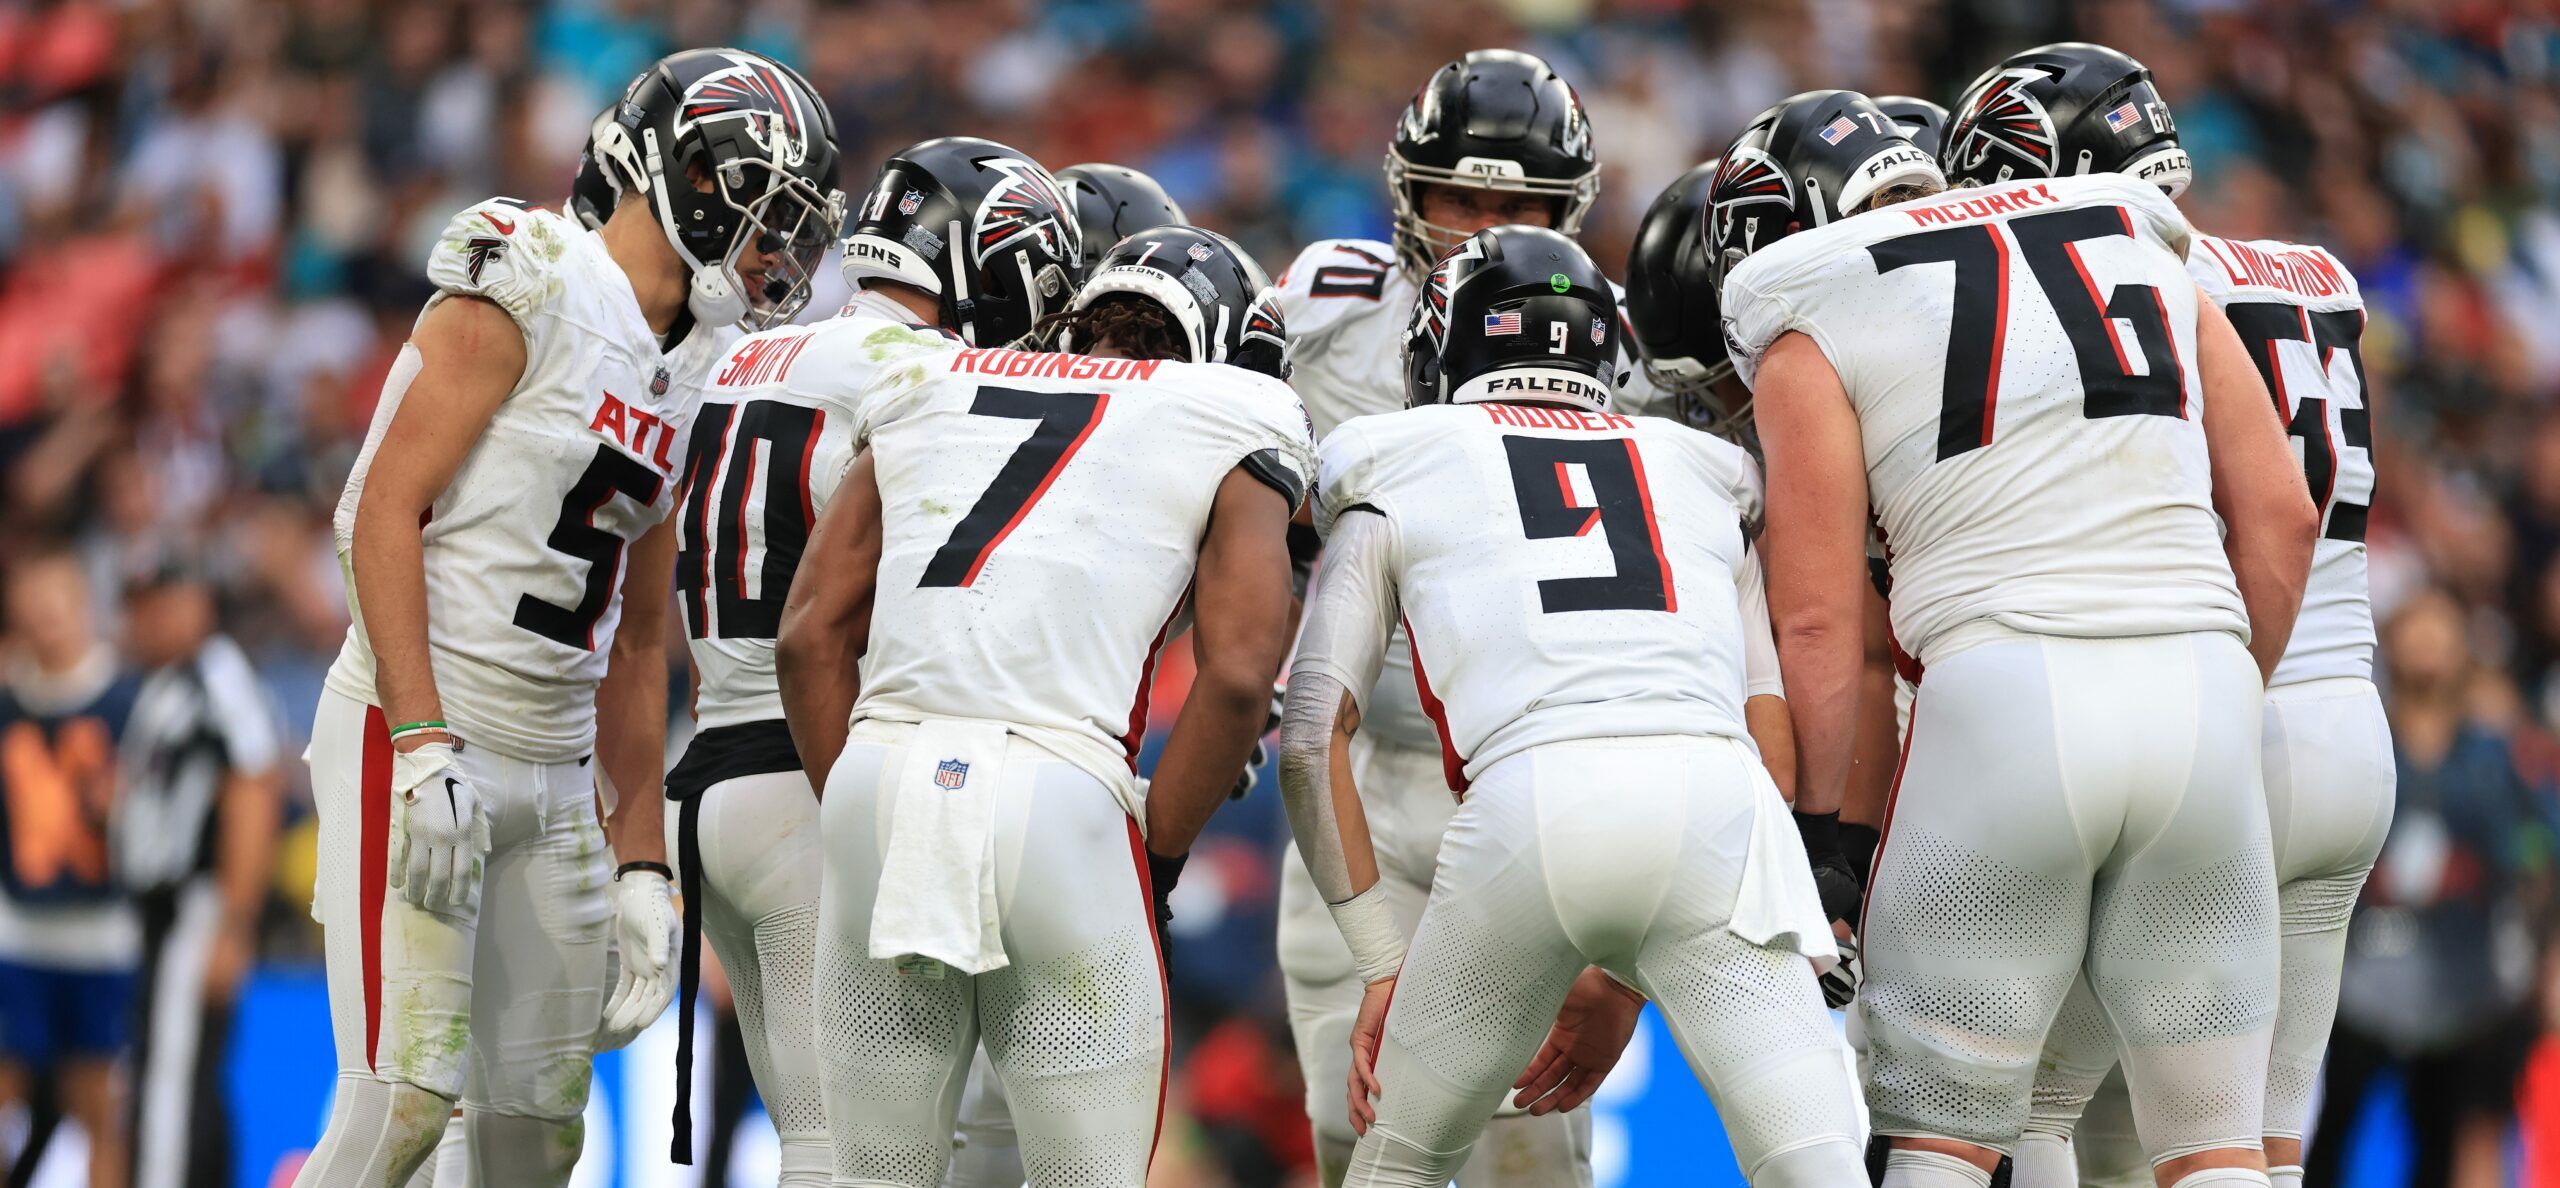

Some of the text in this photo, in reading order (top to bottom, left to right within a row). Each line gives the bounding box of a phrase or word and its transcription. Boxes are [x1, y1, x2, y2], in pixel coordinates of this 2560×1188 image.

[1471, 163, 1505, 177] ATL
[1135, 241, 1162, 266] 7
[950, 349, 1161, 391] ROBINSON
[1487, 377, 1606, 407] FALCONS
[1549, 321, 1568, 355] 9
[1865, 205, 2190, 464] 76
[588, 389, 676, 473] ATL
[916, 385, 1111, 589] 7
[2225, 302, 2376, 544] 63
[512, 442, 664, 653] 5
[676, 401, 826, 640] 40
[1502, 434, 1678, 614] 9
